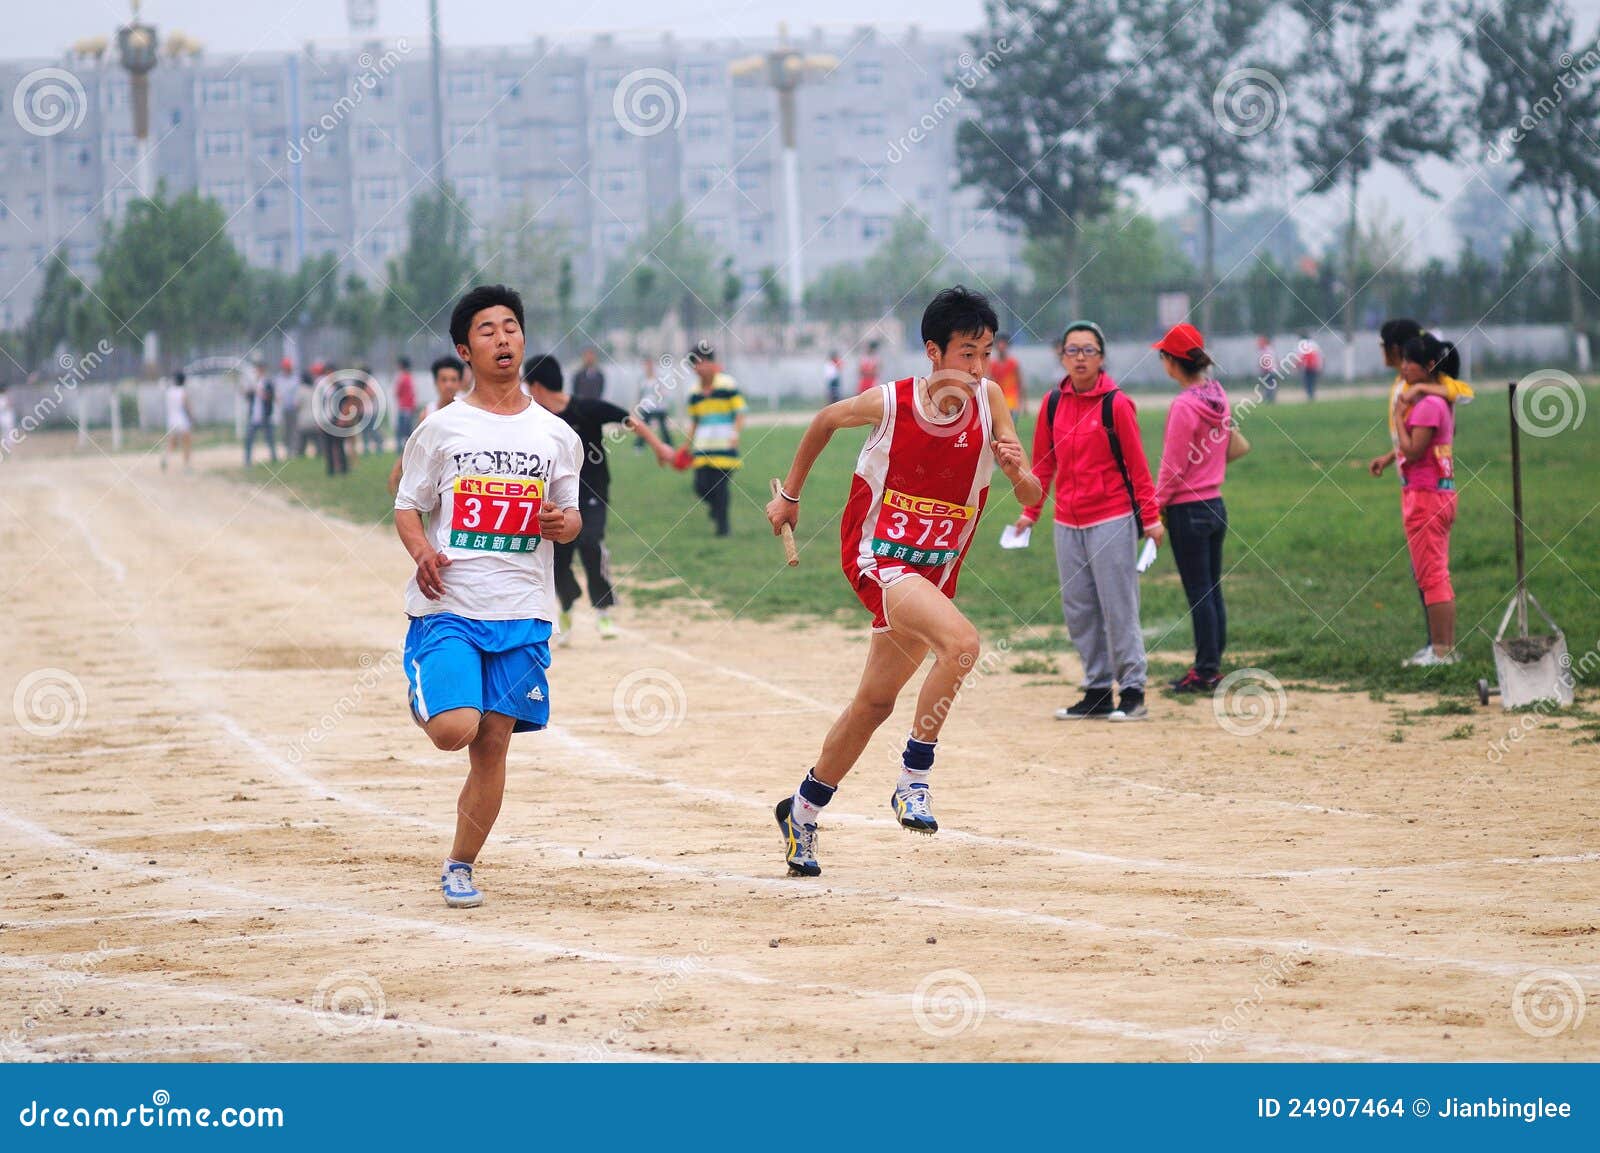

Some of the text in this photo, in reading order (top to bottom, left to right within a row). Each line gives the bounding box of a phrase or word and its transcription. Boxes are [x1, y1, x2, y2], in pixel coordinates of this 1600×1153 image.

[485, 481, 539, 497] CBA
[463, 498, 534, 532] 377
[914, 502, 967, 518] CBA
[886, 512, 954, 547] 372
[455, 532, 537, 551] 挑战新高度
